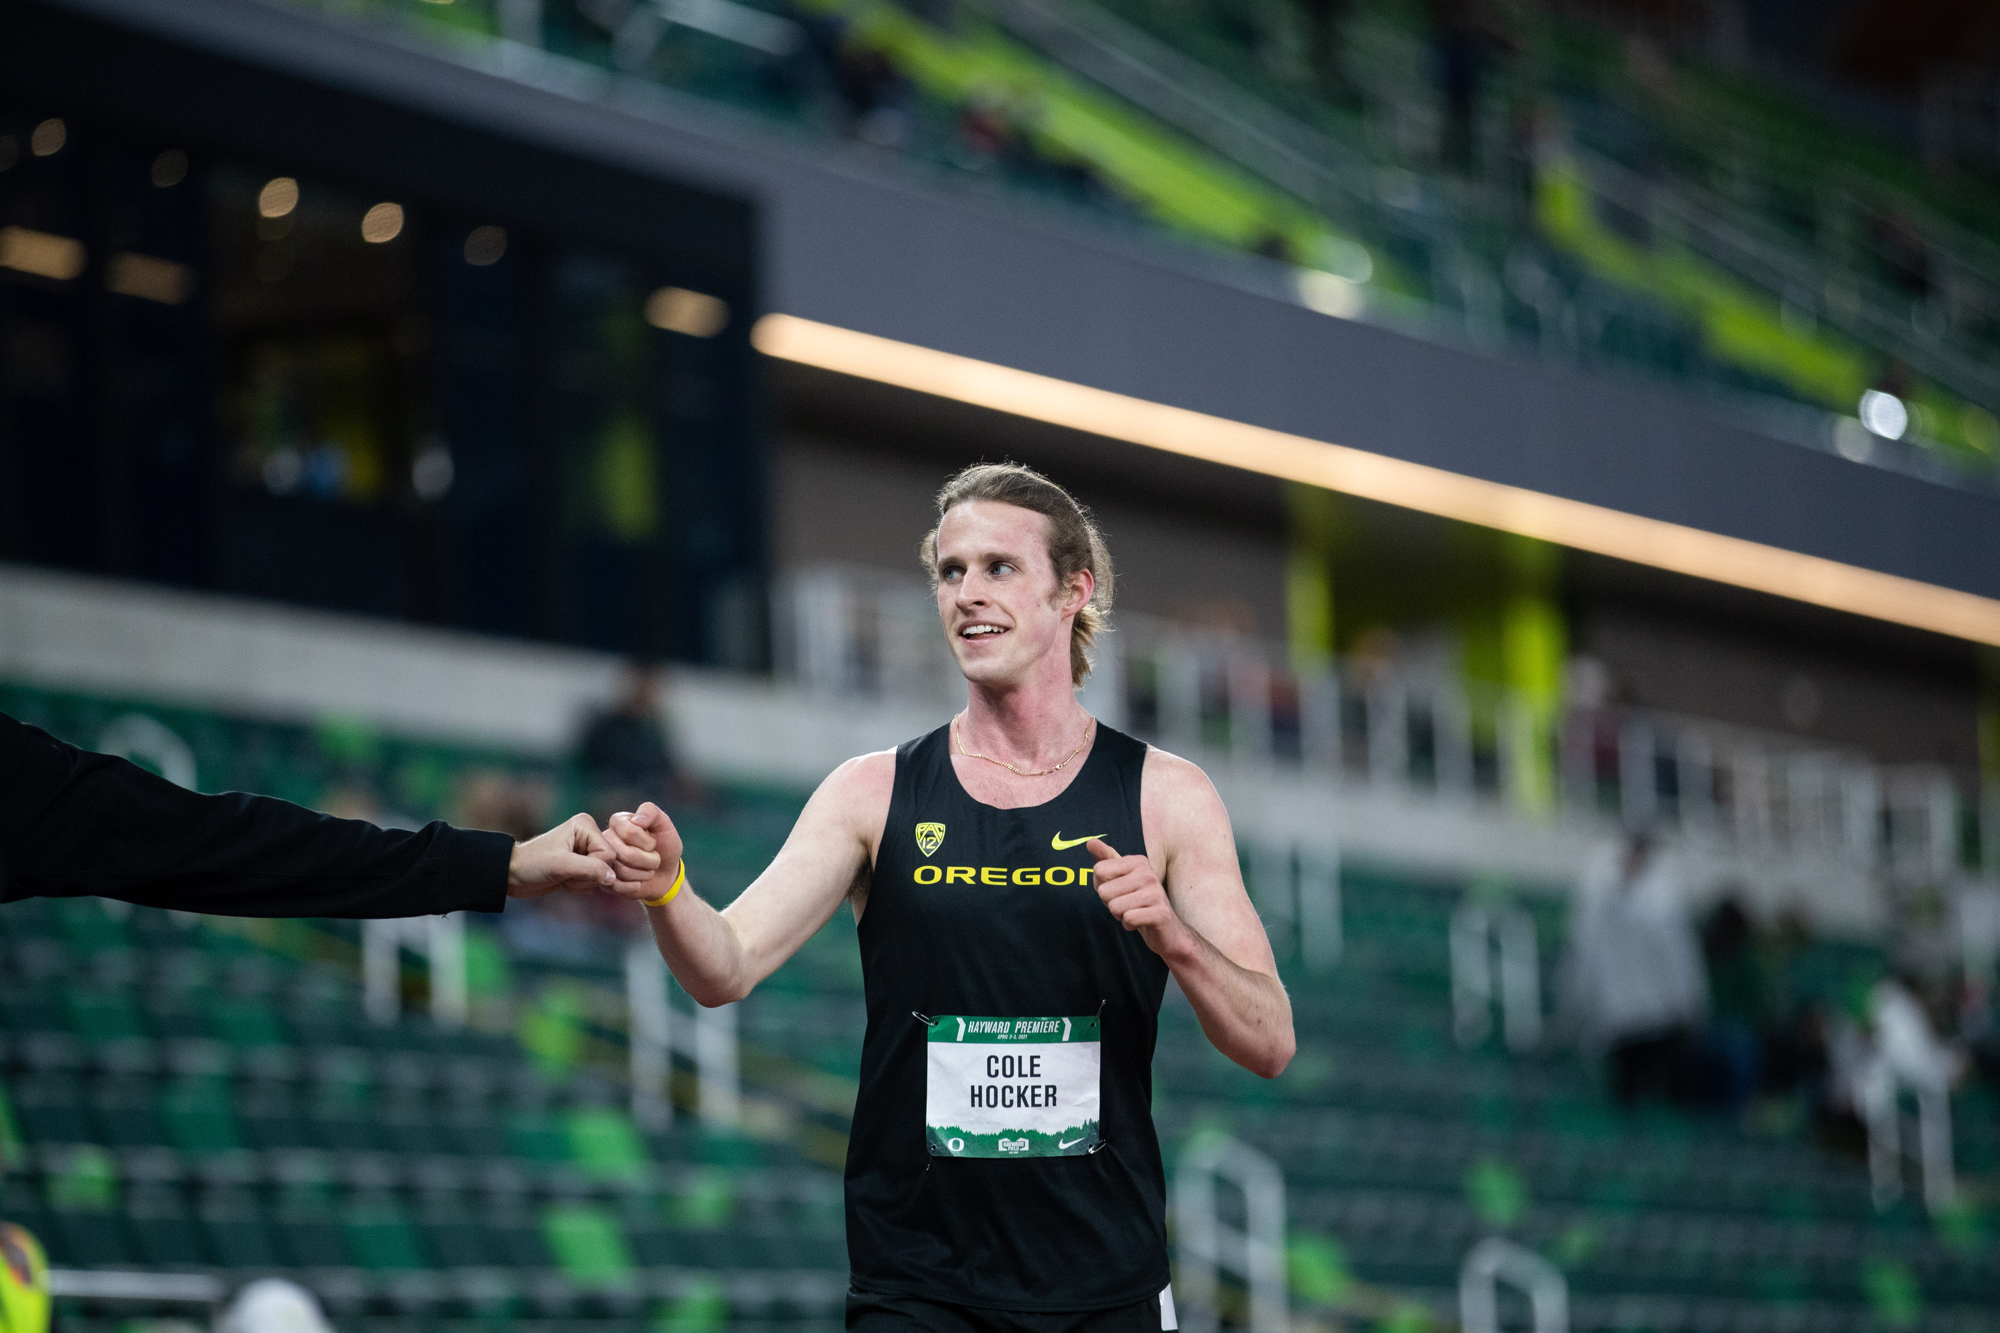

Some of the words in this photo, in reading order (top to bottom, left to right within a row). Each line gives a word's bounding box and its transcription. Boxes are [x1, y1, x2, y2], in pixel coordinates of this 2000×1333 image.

[922, 836, 937, 849] 12
[968, 1020, 1010, 1034] HAYWARD
[1014, 1020, 1061, 1034] PREMIERE
[986, 1055, 1041, 1078] COLE
[970, 1085, 1057, 1108] HOCKER
